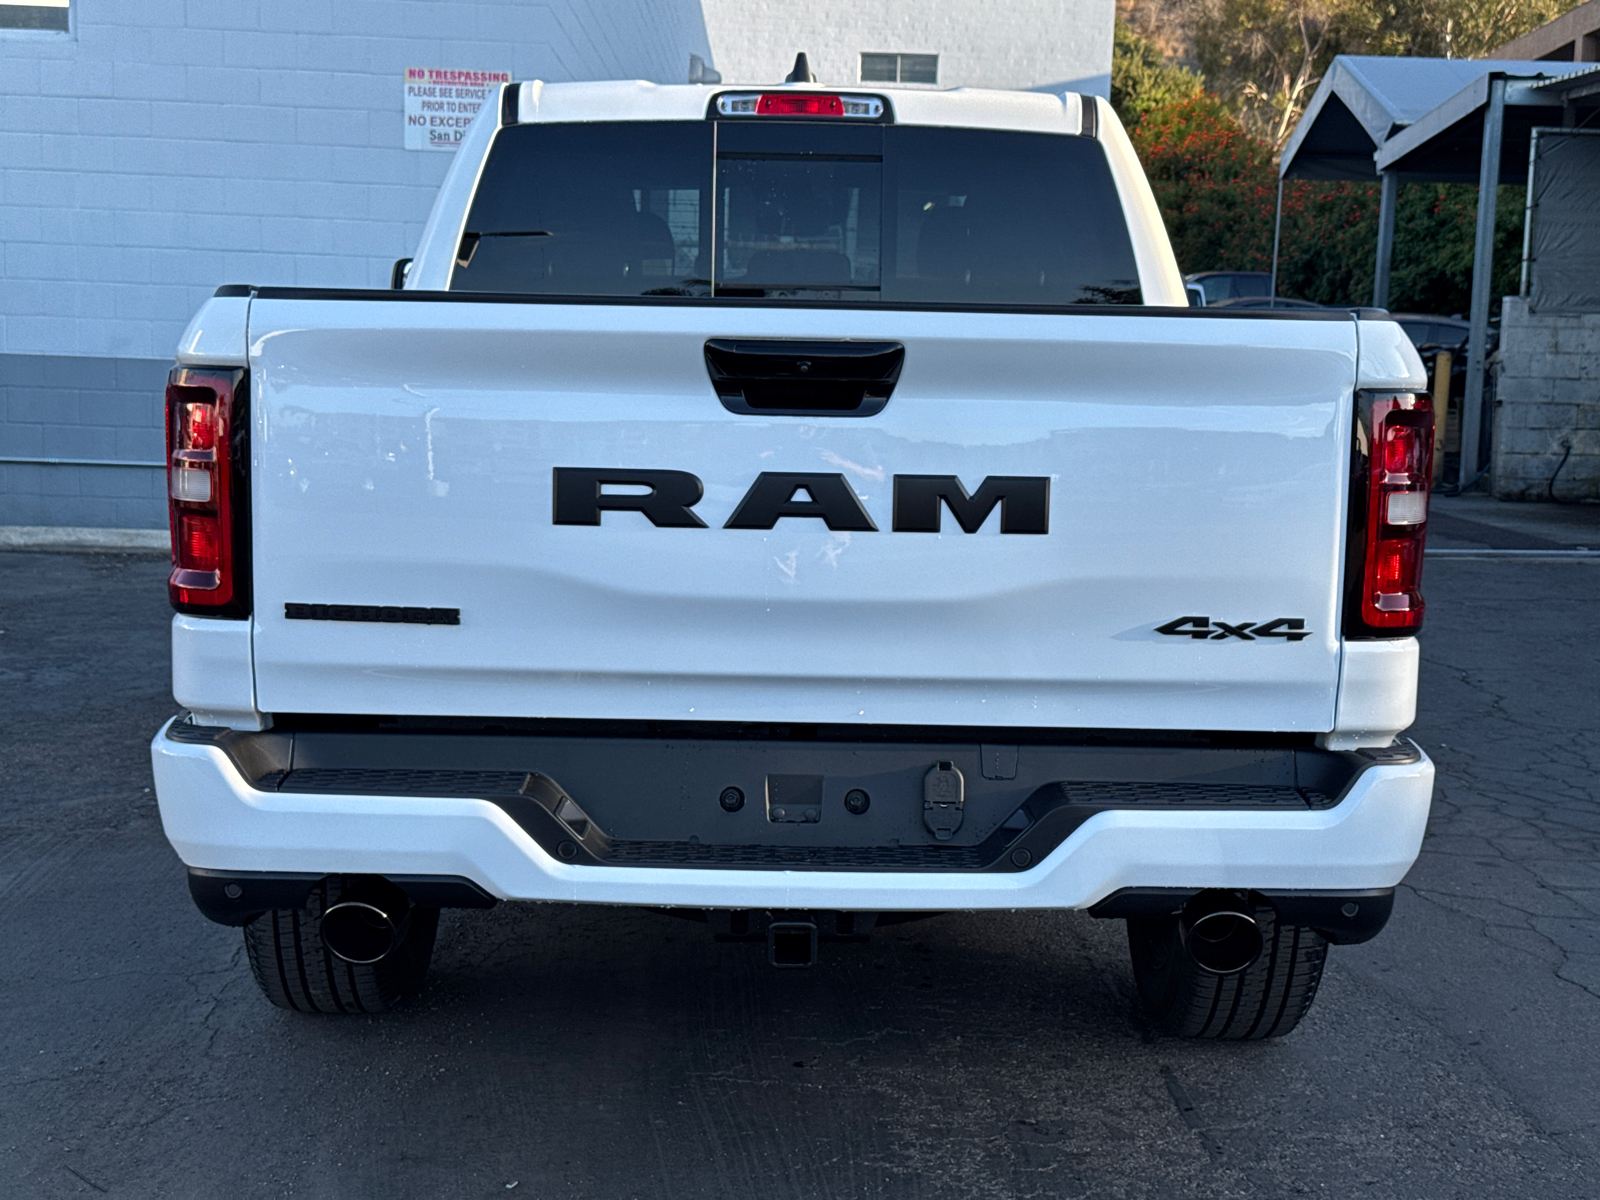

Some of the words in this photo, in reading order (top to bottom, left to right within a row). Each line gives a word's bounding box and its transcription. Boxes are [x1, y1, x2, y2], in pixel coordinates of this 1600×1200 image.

[408, 69, 425, 79] NO
[428, 69, 509, 82] TRESPASSING
[408, 86, 437, 98] PLEASE
[439, 87, 453, 99] SEE
[455, 88, 486, 100] SERVICE
[421, 100, 445, 112] PRIOR
[446, 101, 457, 113] TO
[408, 115, 427, 126] NO
[430, 116, 474, 128] EXCEP
[429, 129, 450, 142] San
[552, 466, 1051, 535] RAM
[284, 602, 461, 625] BIGHORN
[1153, 616, 1313, 641] 4x4
